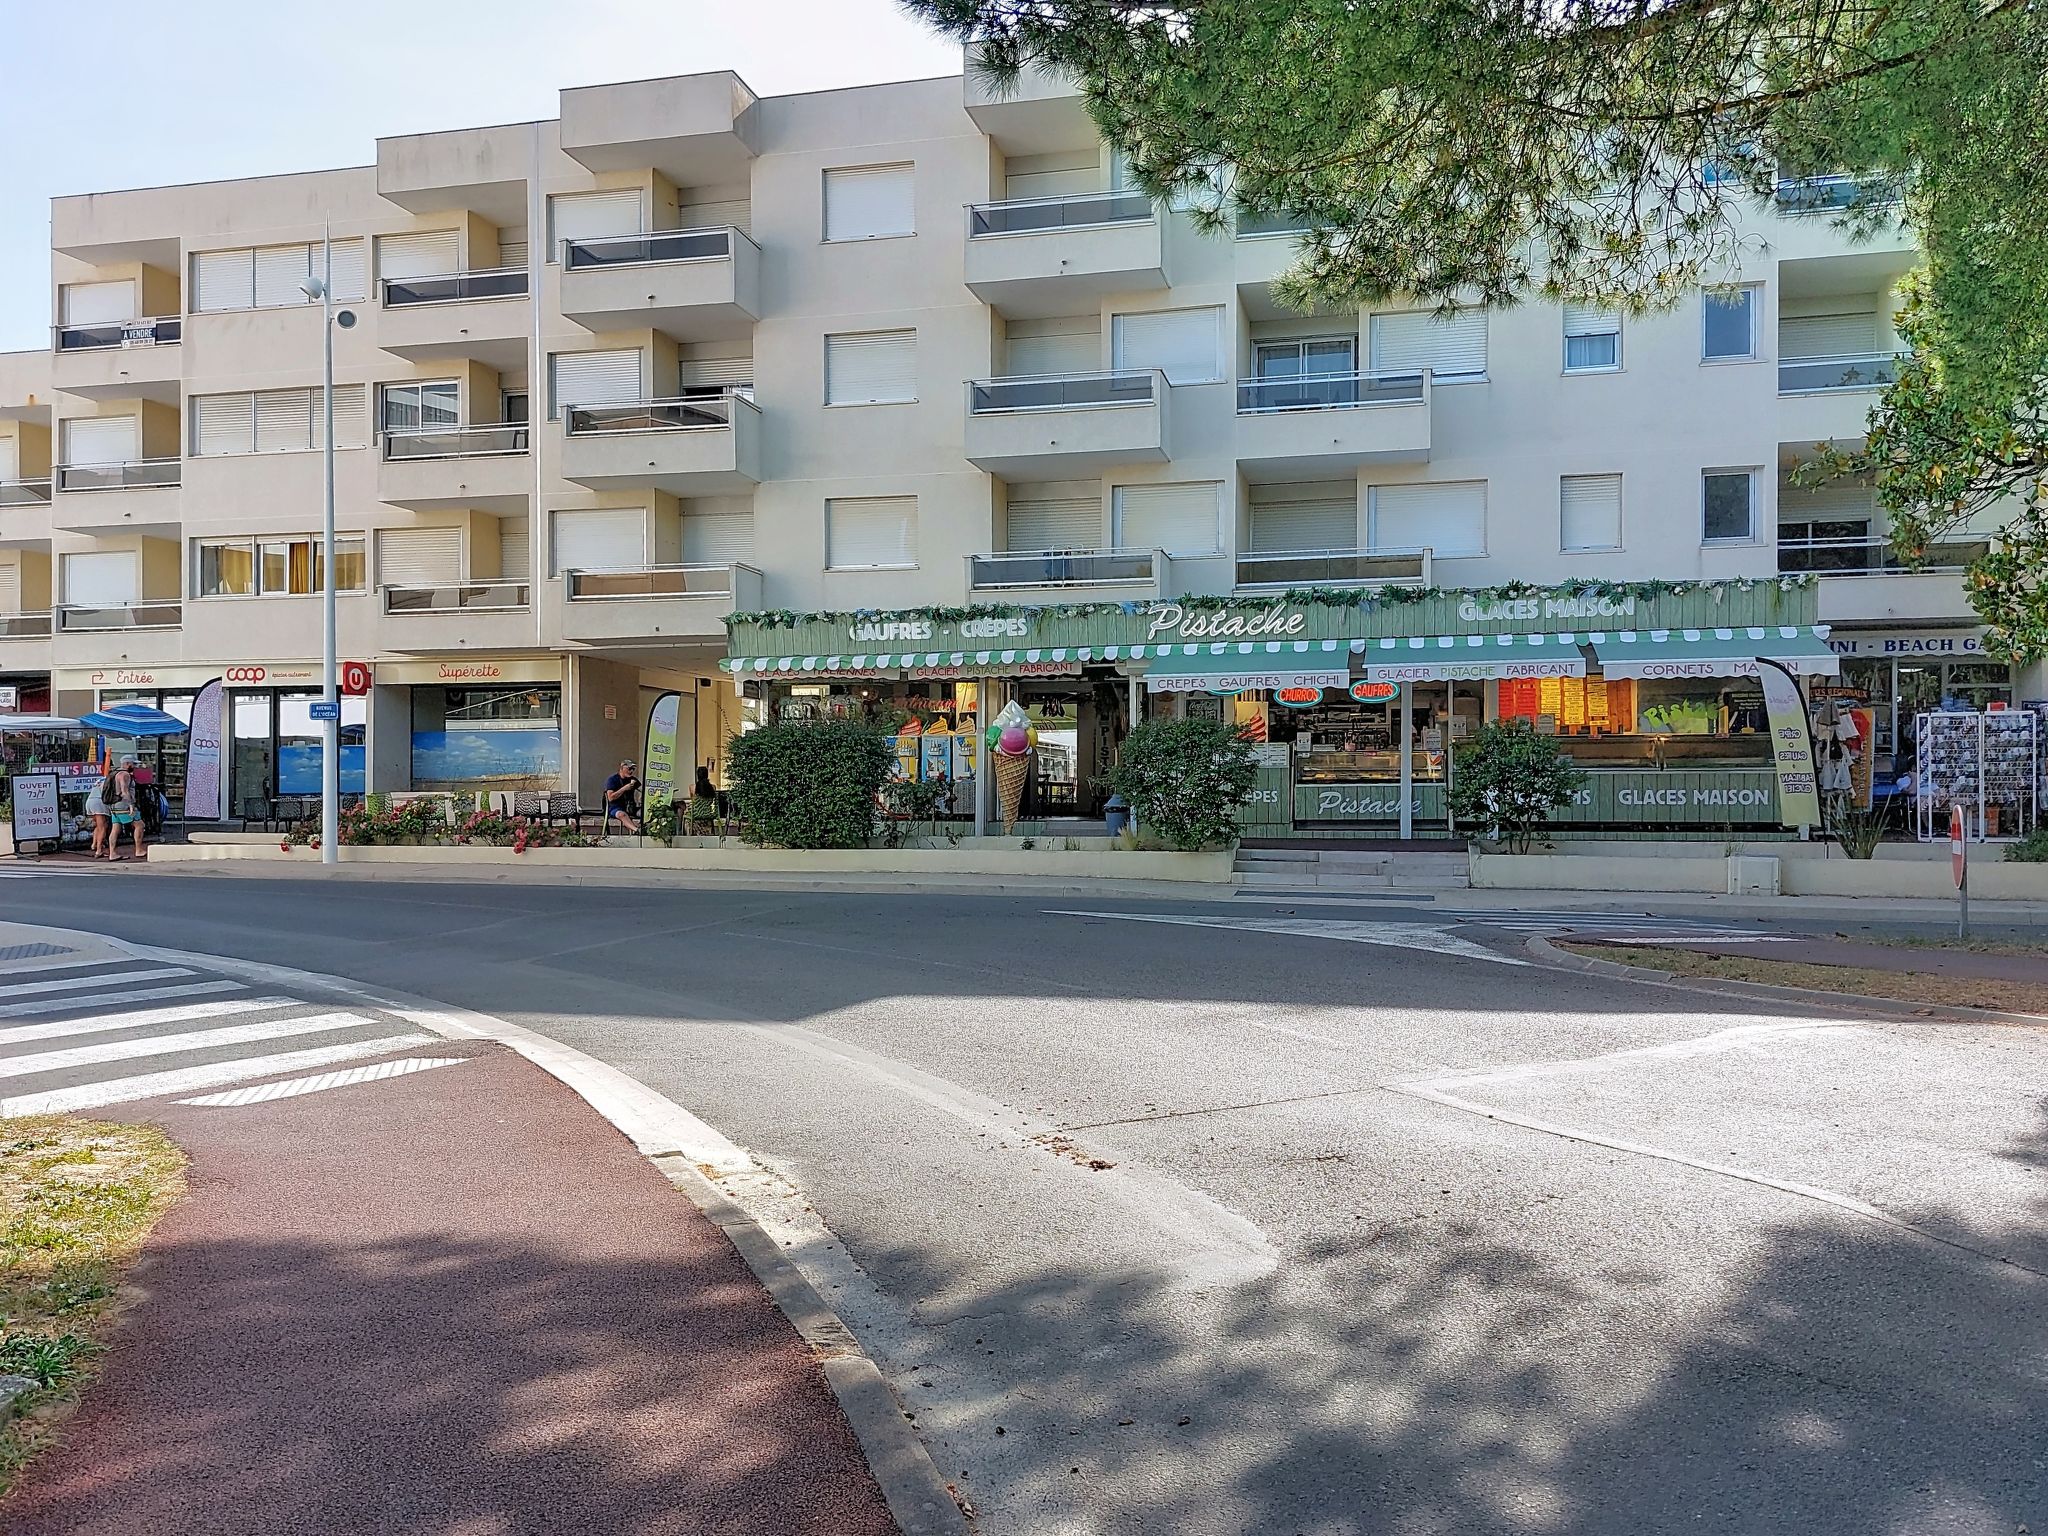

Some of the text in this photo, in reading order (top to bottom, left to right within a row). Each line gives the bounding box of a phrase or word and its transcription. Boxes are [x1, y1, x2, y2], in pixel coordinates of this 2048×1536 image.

[128, 329, 153, 339] VENDRE
[1458, 597, 1635, 621] GLACES MAISON
[1147, 603, 1306, 640] Pistache
[1884, 638, 1953, 652] BEACH
[116, 670, 154, 684] Entrée
[438, 664, 501, 682] Supérette
[916, 663, 1074, 677] GLACIER PISTACHE FABRICANT
[1377, 663, 1575, 679] GLACIER PISTACHE FABRICANT
[1642, 664, 1714, 676] CORNETS
[351, 672, 361, 685] U
[1157, 675, 1340, 689] CREPES GAUFRES CHICHI
[1279, 687, 1319, 702] CHURROS
[1353, 683, 1394, 698] GAUFRES
[82, 764, 102, 775] BOX
[19, 782, 52, 790] OUVERT
[1618, 789, 1769, 806] GLACES MAISON
[32, 806, 54, 815] 8h30
[27, 817, 53, 826] 19h30
